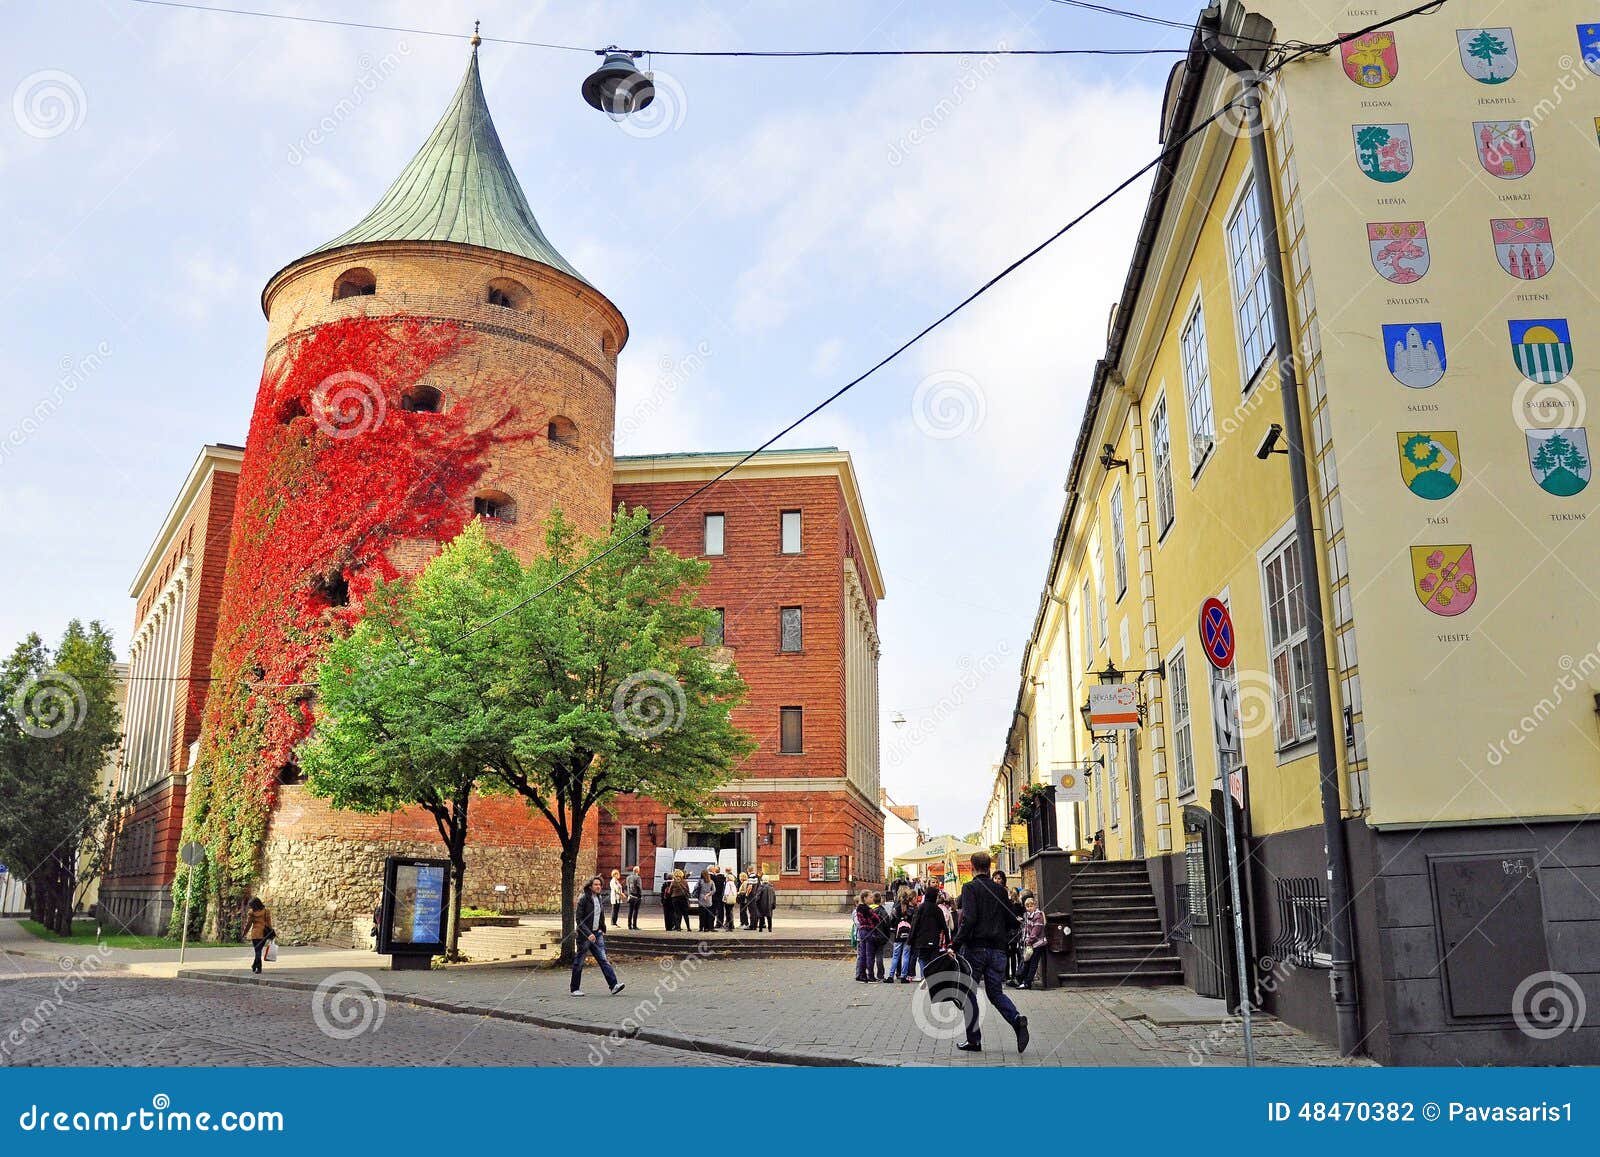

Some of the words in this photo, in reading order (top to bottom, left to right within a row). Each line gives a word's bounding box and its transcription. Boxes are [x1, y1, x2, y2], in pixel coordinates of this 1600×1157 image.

[1360, 99, 1393, 108] JELGAVA
[1516, 293, 1551, 302] PILTENE
[1407, 403, 1440, 412] SALDUS
[1526, 399, 1577, 409] SAULKRASTI
[1426, 516, 1450, 525] TALSI
[1550, 512, 1587, 521] TUKUMS
